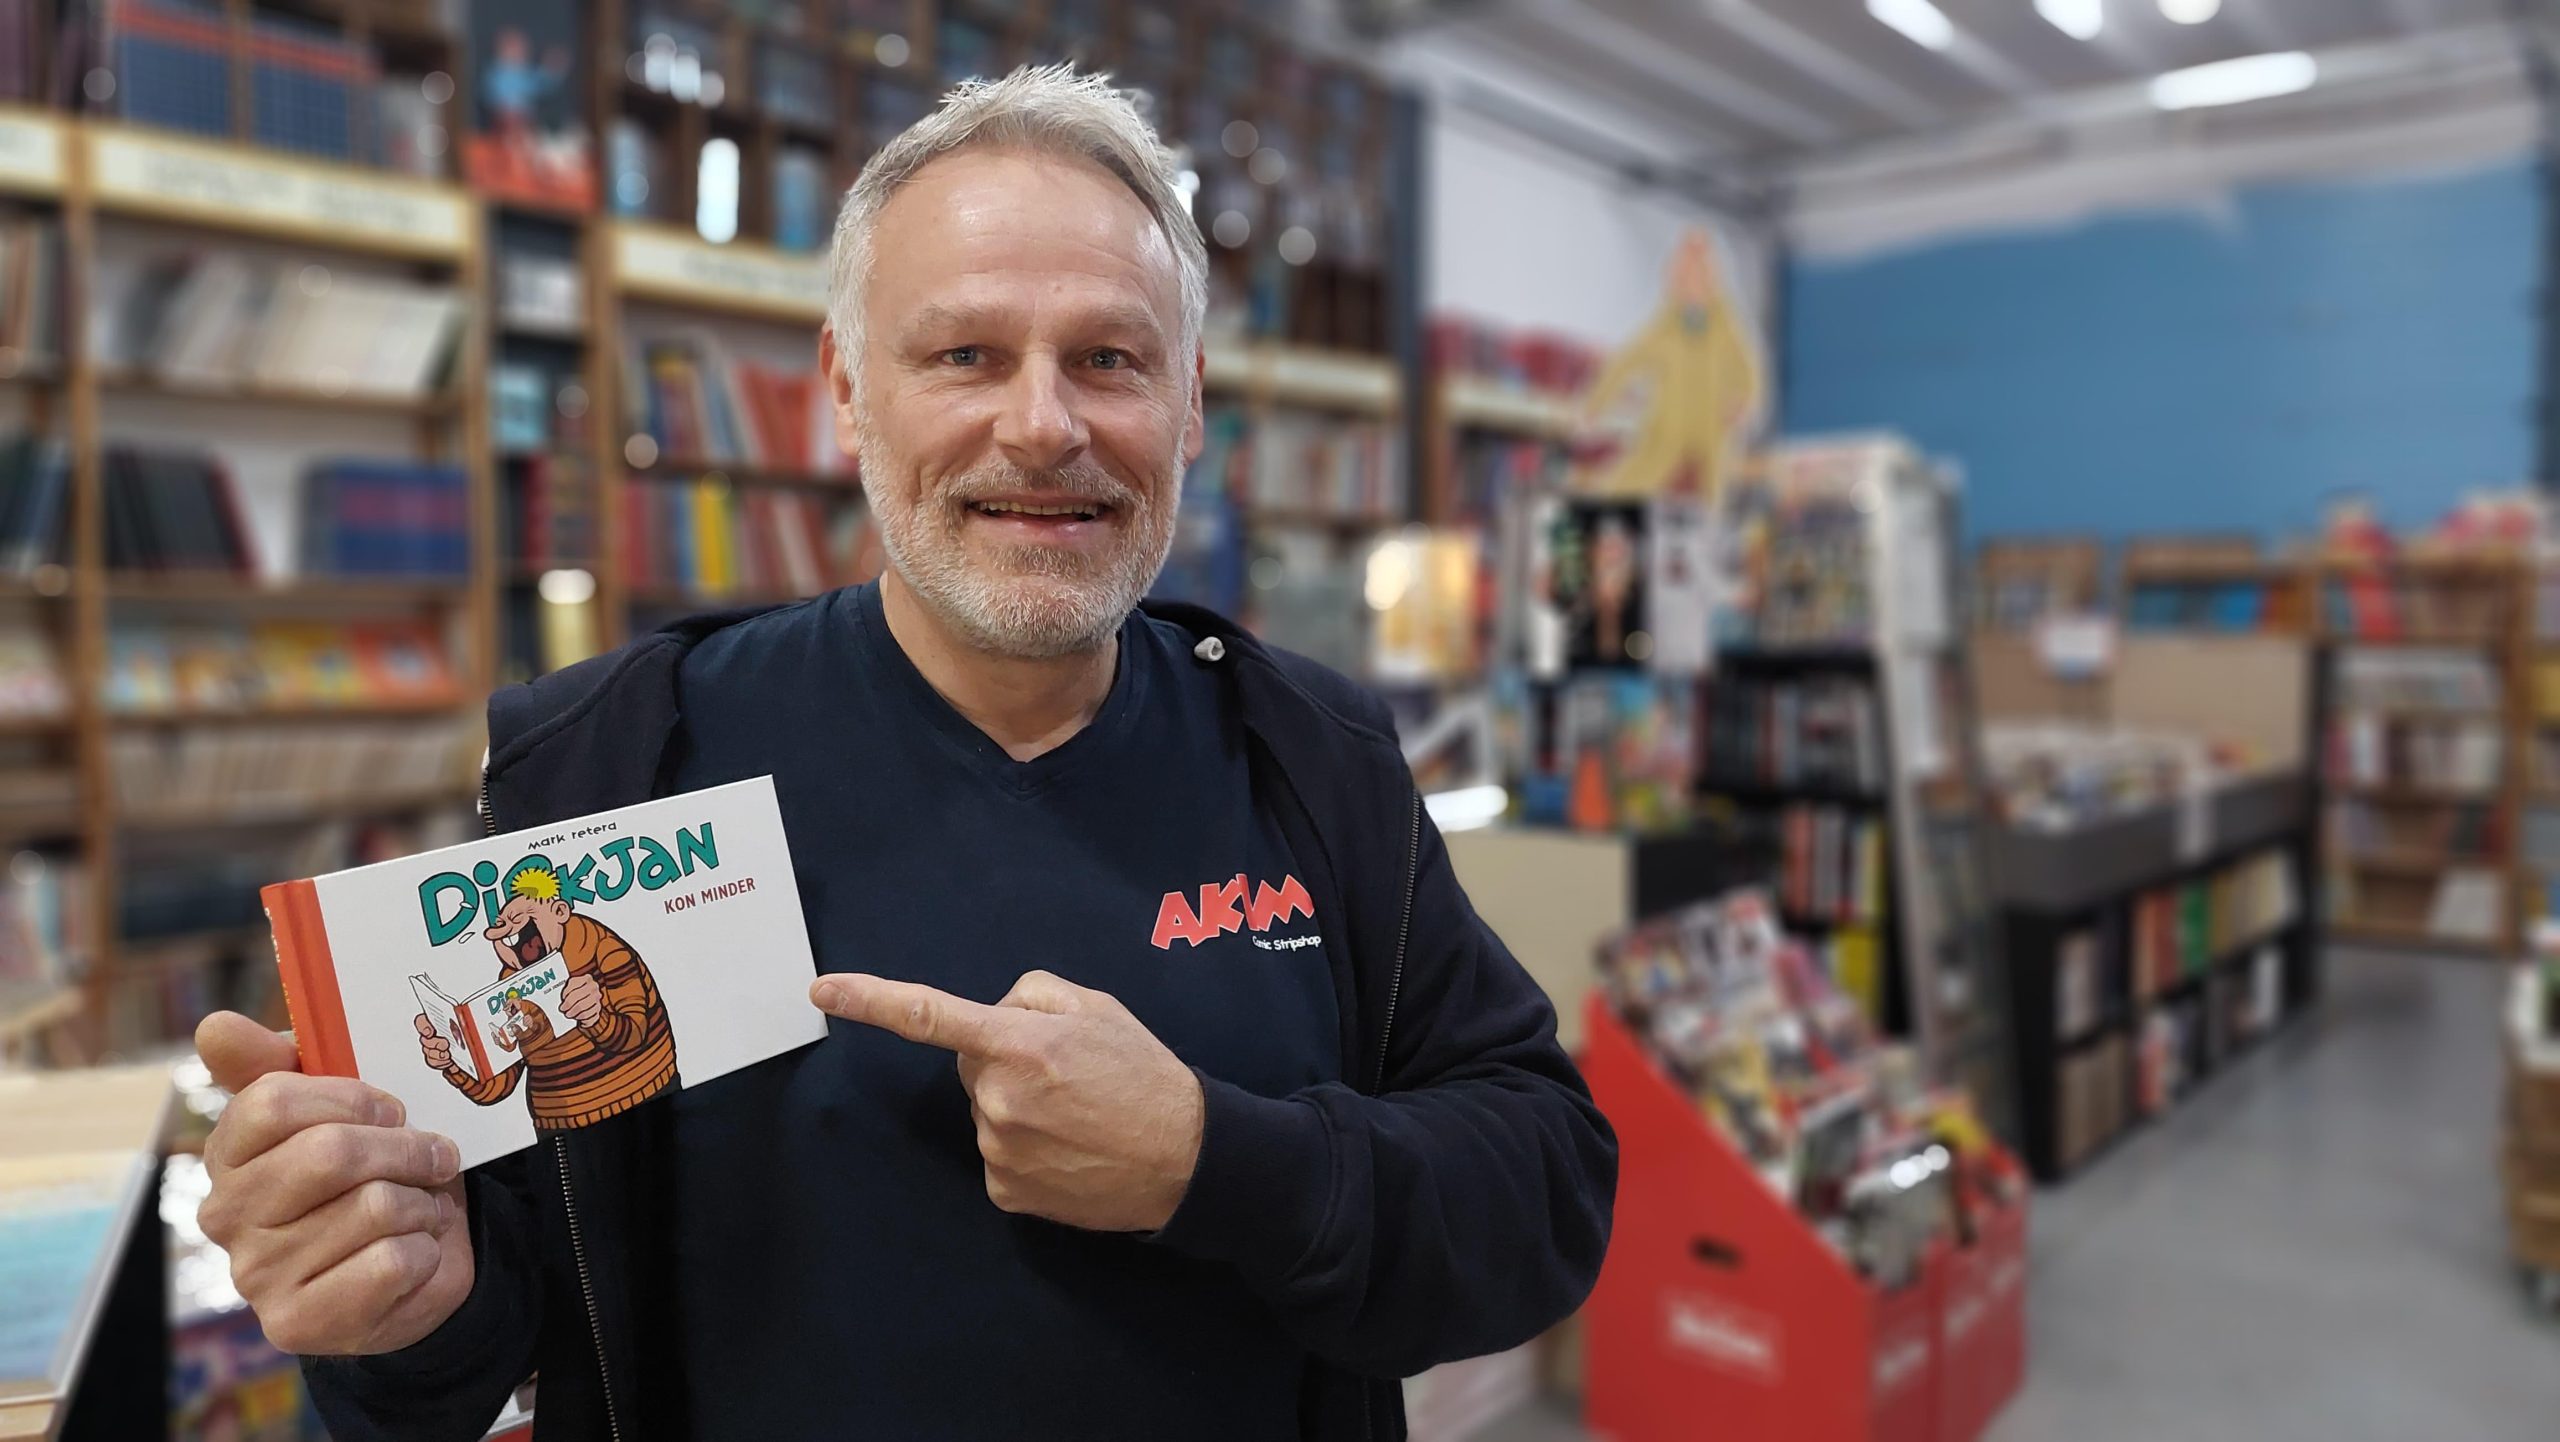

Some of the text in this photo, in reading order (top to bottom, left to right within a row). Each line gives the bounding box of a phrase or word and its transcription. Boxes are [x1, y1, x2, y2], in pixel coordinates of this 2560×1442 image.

[571, 822, 617, 839] retera
[664, 877, 756, 914] KON MINDER
[1273, 935, 1322, 952] Stripshop
